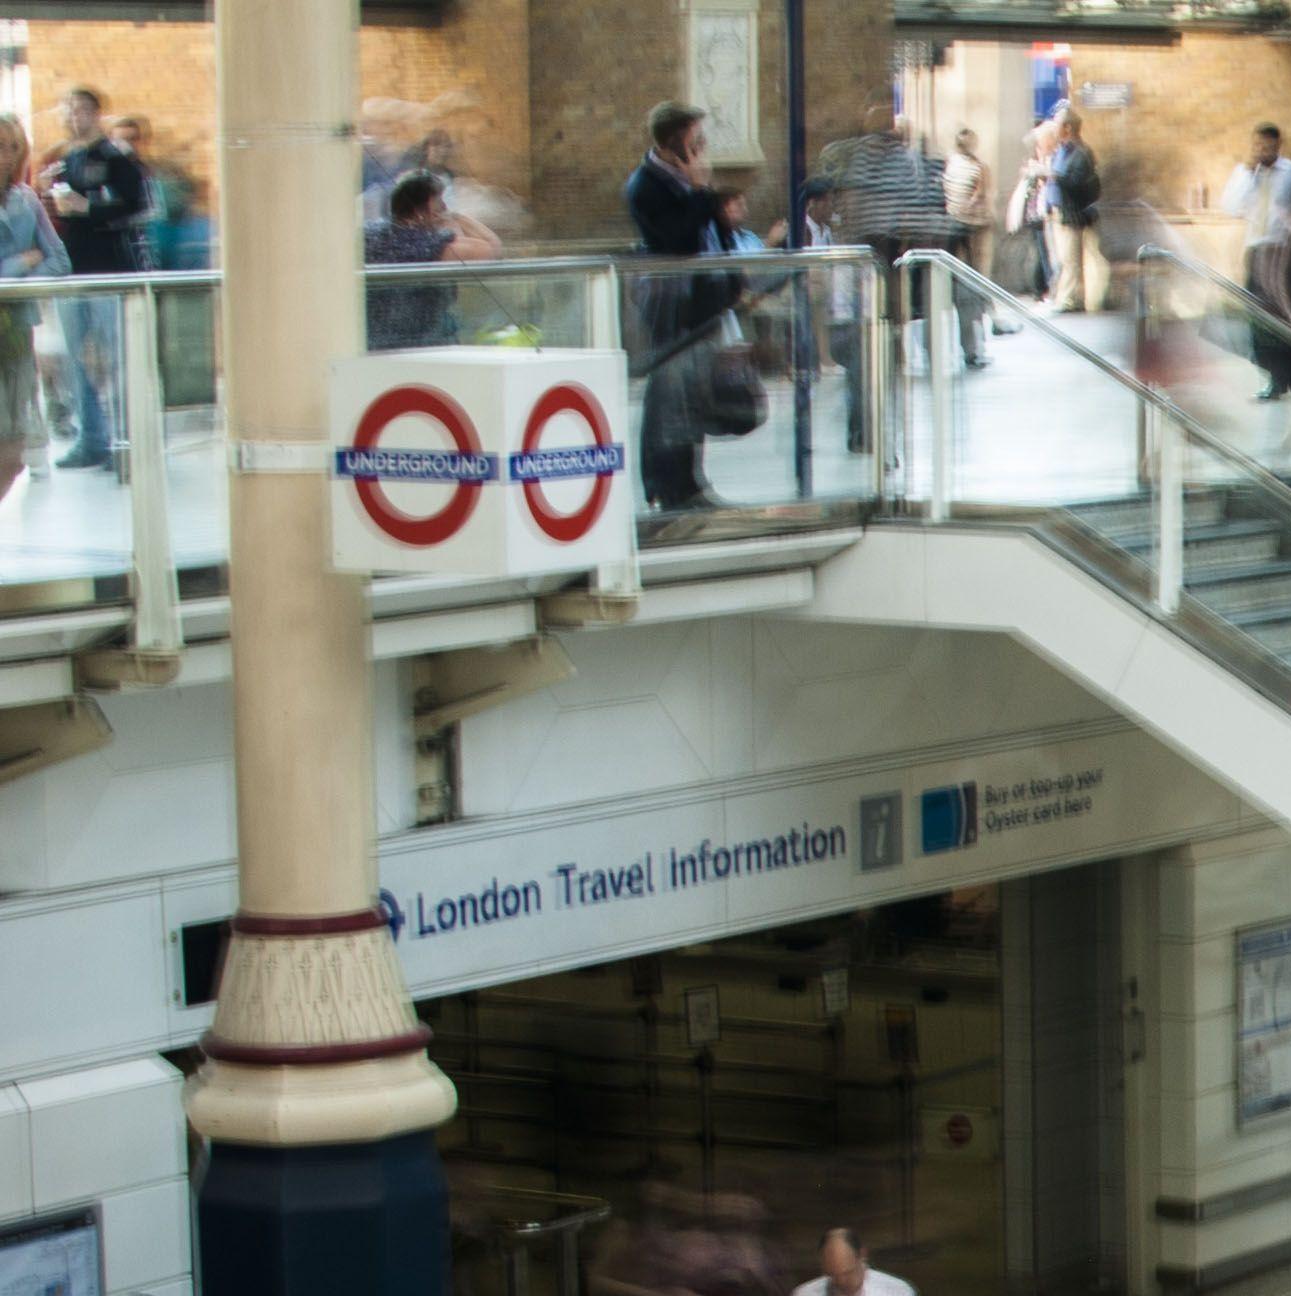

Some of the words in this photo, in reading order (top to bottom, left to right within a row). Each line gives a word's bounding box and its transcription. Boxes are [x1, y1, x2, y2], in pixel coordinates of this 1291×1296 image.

[345, 449, 490, 474] UNDERGROUND
[514, 447, 618, 475] UNDERGROUND
[986, 809, 1029, 834] Oyster
[1032, 798, 1061, 823] card
[418, 877, 542, 937] London
[556, 852, 655, 908] Travel
[670, 822, 846, 891] Information
